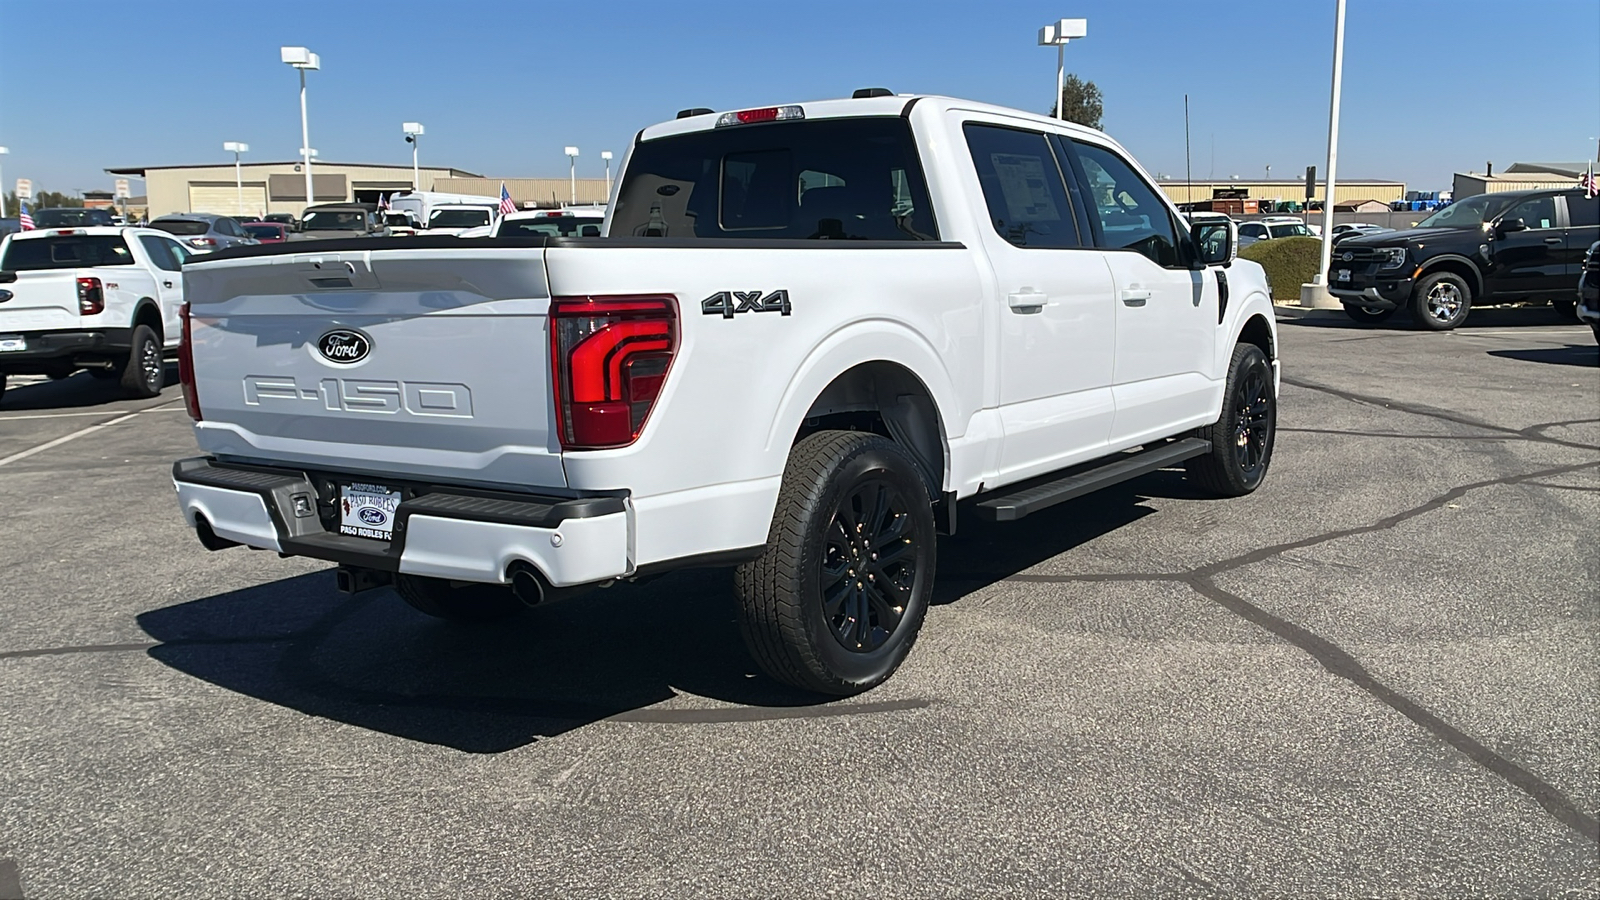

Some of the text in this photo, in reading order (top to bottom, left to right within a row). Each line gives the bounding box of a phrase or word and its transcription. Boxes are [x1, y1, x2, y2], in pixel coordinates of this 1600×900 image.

[325, 334, 360, 358] Ford
[242, 374, 475, 419] F-150
[350, 493, 395, 513] PASO ROBLES
[363, 510, 382, 522] Ford
[340, 526, 357, 535] PASO
[358, 528, 384, 539] ROBLES
